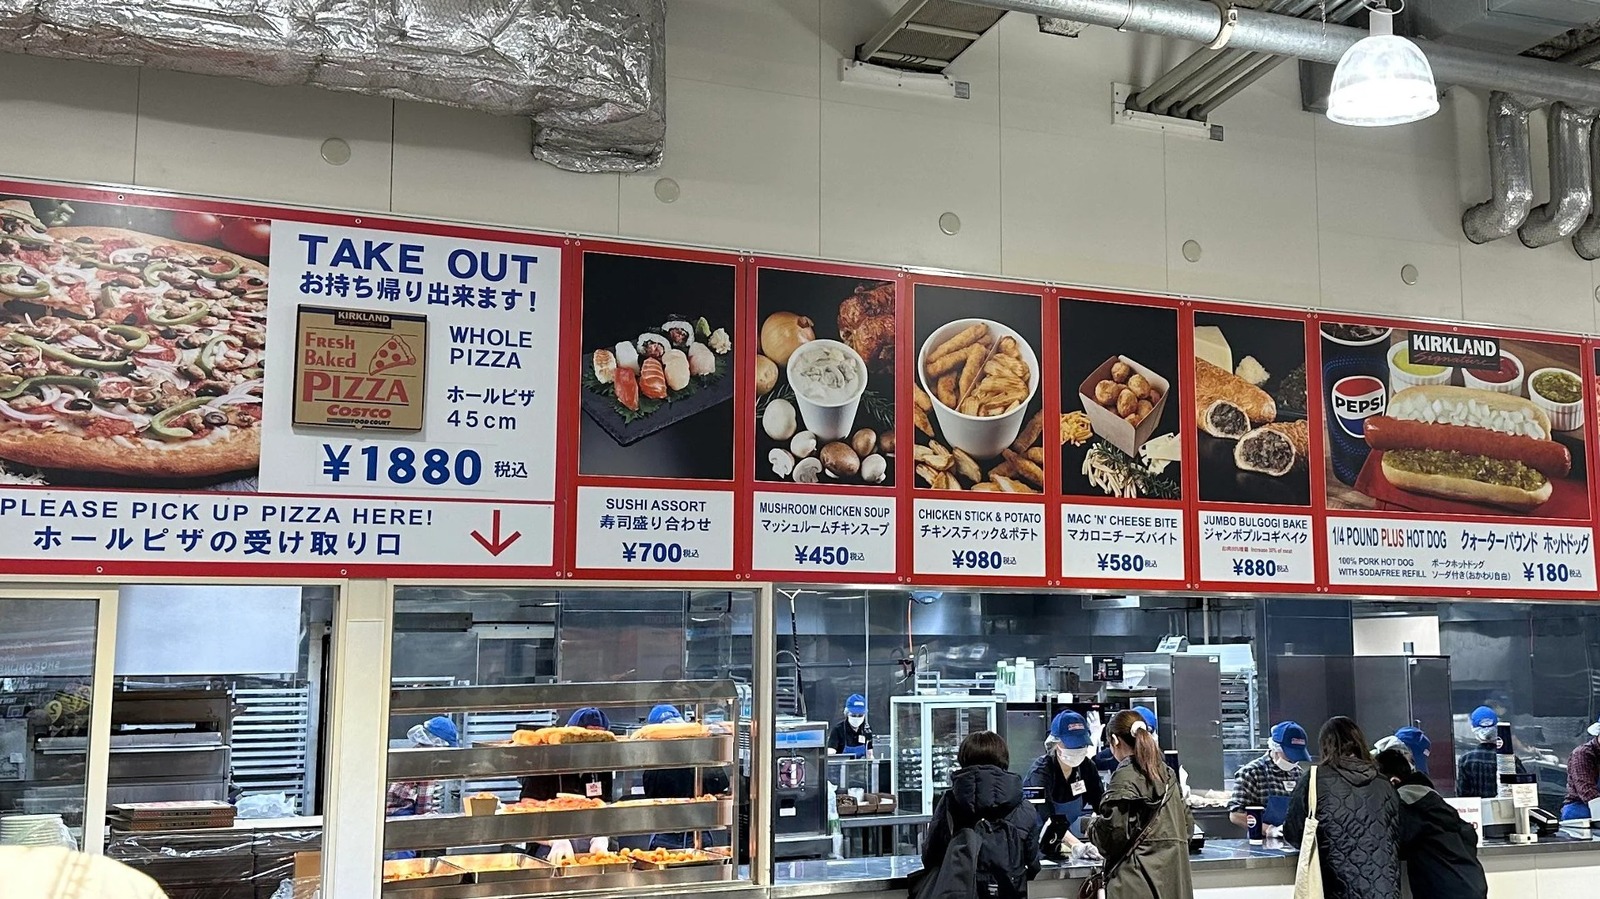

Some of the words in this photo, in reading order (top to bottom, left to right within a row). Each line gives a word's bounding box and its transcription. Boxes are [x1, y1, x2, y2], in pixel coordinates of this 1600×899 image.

[299, 233, 425, 275] TAKE
[447, 249, 538, 284] OUT
[338, 311, 390, 323] KIRKLAND
[449, 325, 532, 348] WHOLE
[1413, 334, 1497, 357] KIRKLAND
[450, 348, 522, 369] PIZZA
[1414, 351, 1498, 365] Signature
[302, 371, 409, 403] PIZZA
[447, 385, 535, 407] ホールピザ
[326, 404, 392, 418] COSTCO
[1335, 394, 1384, 413] PEPSI
[322, 443, 482, 485] ¥1880
[494, 460, 528, 479] 税込
[0, 497, 118, 518] PLEASE
[132, 501, 200, 521] PICK
[212, 504, 249, 522] UP
[261, 505, 341, 524] PIZZA
[352, 507, 433, 526] HERE!
[606, 498, 648, 511] SUSHI
[651, 499, 707, 512] ASSORT
[759, 502, 817, 515] MUSHROOM
[819, 504, 862, 517] CHICKEN
[864, 506, 890, 518] SOUP
[600, 514, 711, 531] 寿司盛り合わせ
[918, 508, 962, 521] CHICKEN
[964, 510, 993, 522] STICK
[995, 512, 1002, 522] &
[1004, 512, 1041, 524] POTATO
[1067, 513, 1091, 524] MAC
[1109, 515, 1152, 527] CHEESE
[1154, 517, 1178, 528] BITE
[1203, 515, 1237, 526] JUMBO
[1239, 516, 1280, 528] BULGOGI
[1282, 518, 1308, 530] BAKE
[761, 519, 890, 536] マッシュルームチキンスープ
[1067, 528, 1177, 545] マカロニチーズバイト
[33, 525, 401, 556] ホールピザの受け取り口
[1332, 526, 1345, 546] 1/4
[1346, 526, 1379, 547] POUND
[1381, 528, 1405, 548] PLUS
[1406, 528, 1424, 548] HOT
[1427, 530, 1447, 549] DOG
[1543, 532, 1591, 555] ホットドッグ
[622, 542, 682, 563] ¥700
[794, 545, 849, 565] ¥450
[952, 550, 1002, 569] ¥980
[1338, 557, 1357, 565] 100%
[1358, 557, 1380, 566] PORK
[1381, 558, 1396, 566] HOT
[1397, 558, 1415, 567] DOG
[1097, 553, 1144, 572] ¥580
[1232, 558, 1276, 576] ¥880
[1522, 562, 1569, 582] ¥180
[1338, 568, 1358, 576] WITH
[1358, 568, 1401, 577] SODA/FREE
[1402, 569, 1427, 578] REFILL
